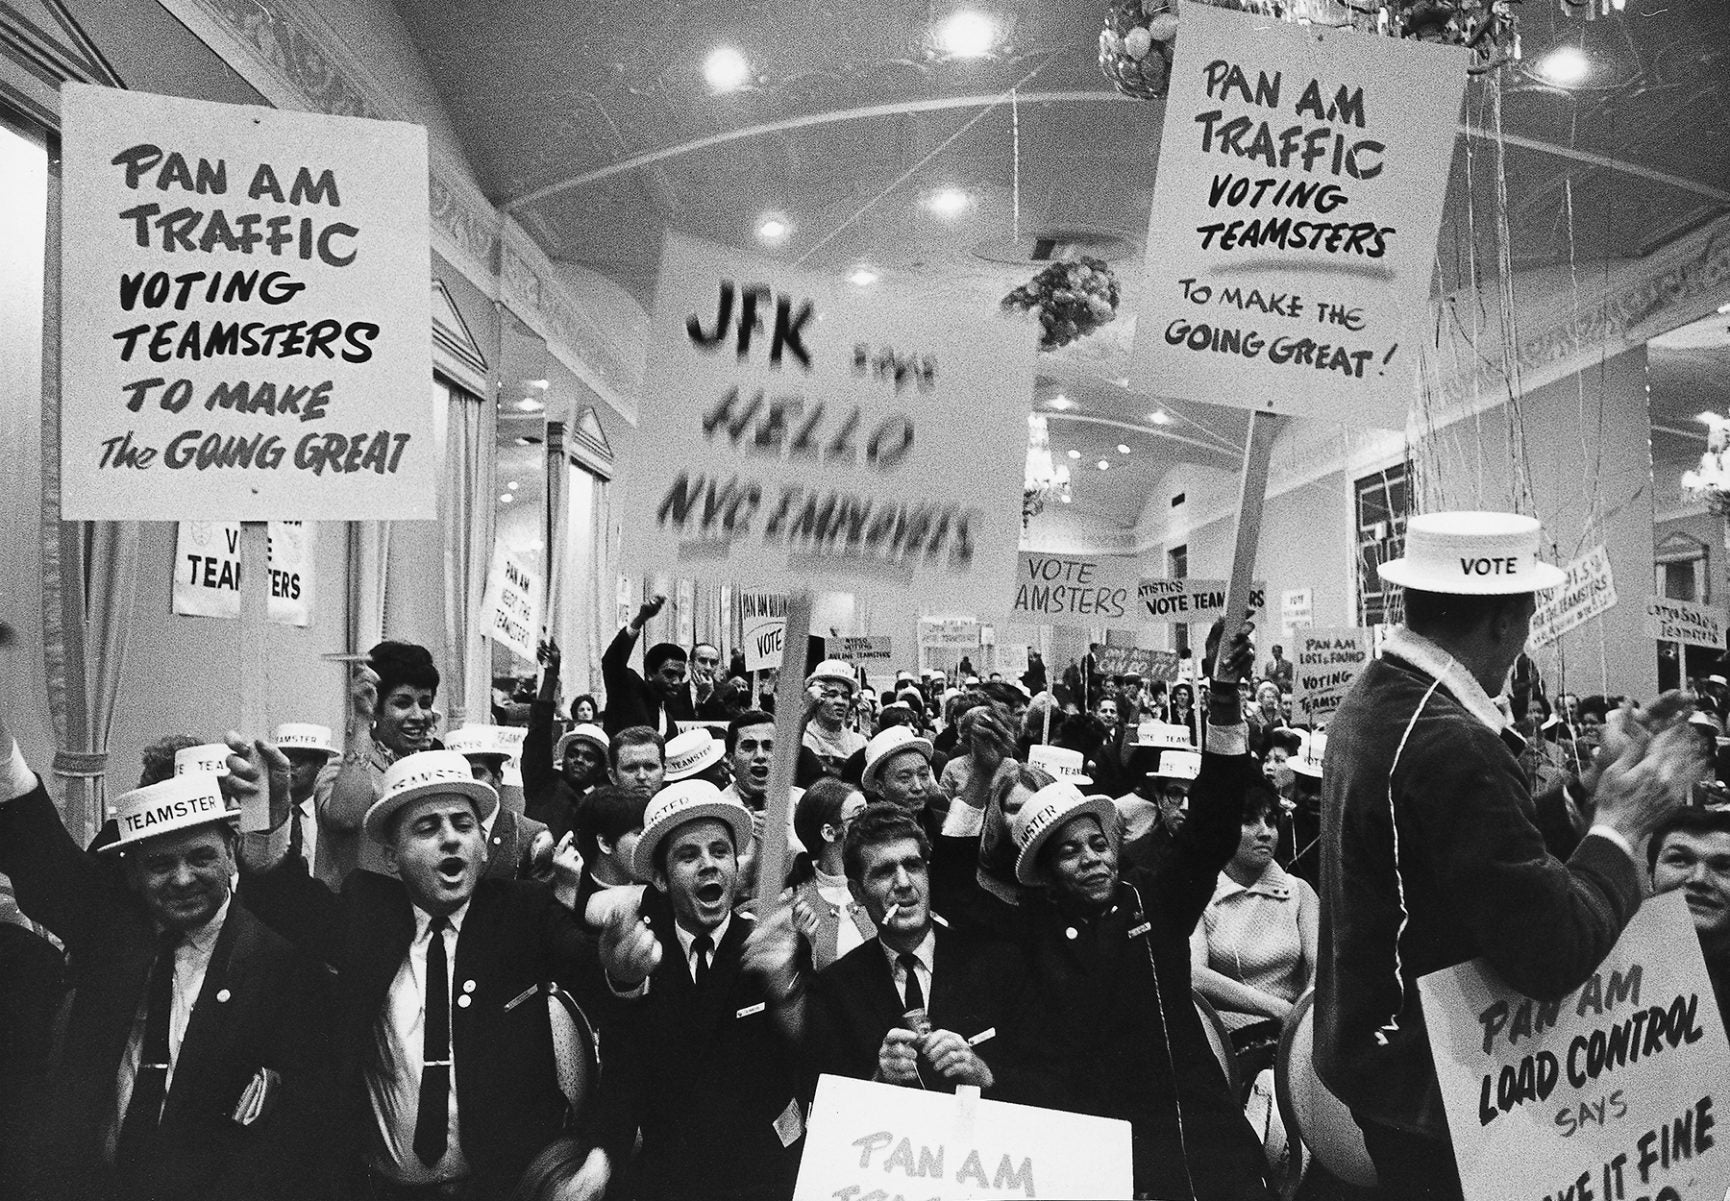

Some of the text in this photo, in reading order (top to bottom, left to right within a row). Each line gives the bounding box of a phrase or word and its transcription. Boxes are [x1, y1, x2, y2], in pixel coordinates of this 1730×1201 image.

[1203, 60, 1366, 128] PAN AM
[1194, 110, 1386, 180] TRAFFIC
[111, 144, 340, 207] PAN AM
[1207, 173, 1349, 214] VOTING
[118, 203, 360, 268] TRAFFIC
[1196, 217, 1396, 258] TEAMSTERS
[119, 269, 306, 311] VOTING
[1178, 278, 1367, 331] TO MAKE THE
[113, 319, 380, 363] TEAMSTERS
[685, 277, 816, 371] JFK
[1165, 319, 1265, 358] GOING
[122, 378, 334, 422] TO MAKE
[703, 386, 915, 466] HELLO
[99, 430, 411, 476] The GOING GREAT
[1028, 558, 1098, 584] VOTE
[1460, 557, 1518, 576] VOTE
[1014, 584, 1128, 618] AMSTERS
[1138, 581, 1184, 598] ATISTICS
[1146, 590, 1264, 615] VOTE TEAMRS
[756, 628, 783, 659] VOTE
[1305, 639, 1356, 652] PAN AM
[1302, 671, 1353, 690] VOTING
[1299, 695, 1343, 715] TEAMST
[126, 795, 216, 833] TEAMSTER
[1479, 963, 1643, 1056] PAN AM
[1479, 993, 1703, 1127] LOAD CONTROL
[1554, 1089, 1628, 1138] SAYS
[1637, 1095, 1716, 1185] FINE
[851, 1131, 1036, 1198] PAN AM
